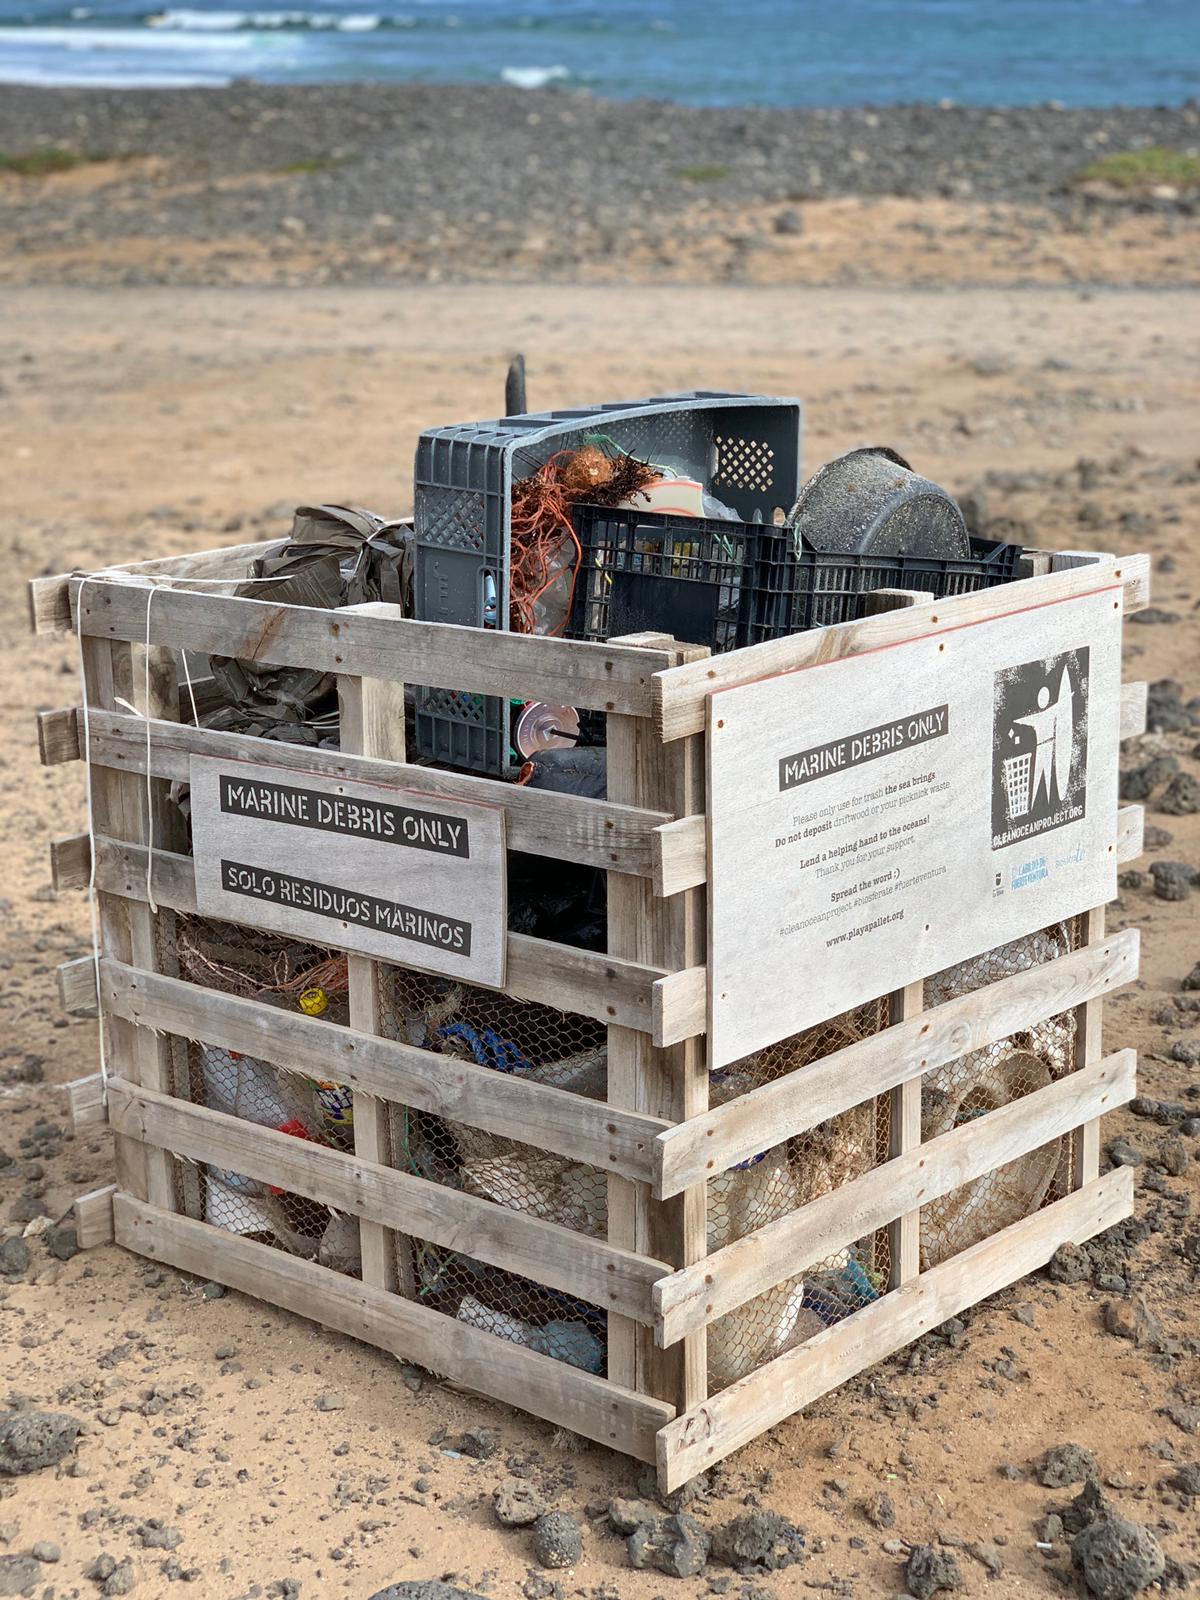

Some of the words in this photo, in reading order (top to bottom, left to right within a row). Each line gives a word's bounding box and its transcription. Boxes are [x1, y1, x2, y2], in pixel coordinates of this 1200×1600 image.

[785, 744, 846, 784] MARINE
[851, 725, 903, 761] DEBRIS
[908, 711, 945, 741] ONLY
[227, 783, 310, 821] MARINE
[317, 798, 395, 837] DEBRIS
[402, 815, 462, 850] ONLY
[775, 837, 787, 848] Do
[788, 832, 802, 844] not
[803, 820, 832, 839] deposit
[833, 806, 870, 827] driftwood
[870, 805, 879, 815] or
[880, 801, 898, 815] your
[898, 787, 929, 808] picknick
[793, 813, 818, 827] Please
[819, 804, 836, 819] only
[837, 801, 850, 812] use
[851, 795, 863, 809] for
[864, 788, 884, 803] trash
[885, 781, 898, 795] the
[898, 779, 911, 789] sea
[912, 771, 936, 786] brings
[992, 805, 1083, 848] CLEANOCEANPROJECT.ORG
[800, 853, 820, 869] Lend
[822, 853, 827, 861] a
[828, 840, 858, 859] helping
[859, 833, 878, 848] hand
[880, 830, 888, 840] to
[889, 824, 901, 837] the
[902, 814, 930, 832] oceans!
[815, 863, 840, 879] Thank
[840, 858, 856, 873] you
[856, 852, 868, 865] for
[867, 847, 885, 862] your
[227, 866, 275, 897] SOLO
[279, 878, 371, 922] RESIDUOS
[375, 903, 464, 948] MARINOS
[830, 884, 858, 903] Spread
[859, 878, 872, 892] the
[873, 871, 892, 886] word
[825, 908, 905, 948] www.playapallet.org
